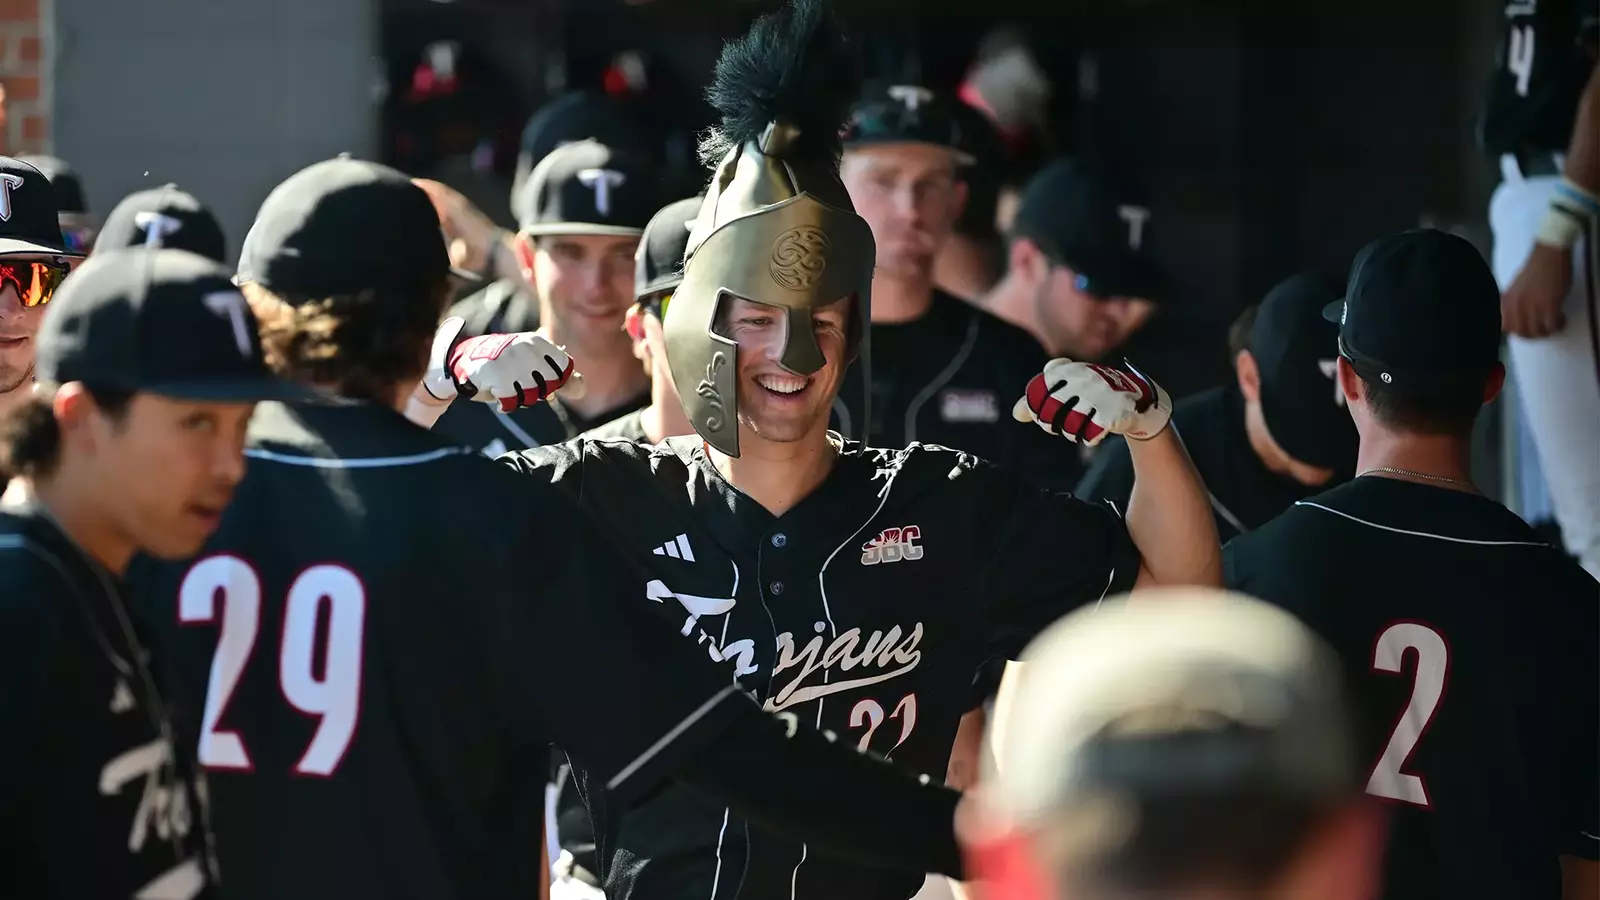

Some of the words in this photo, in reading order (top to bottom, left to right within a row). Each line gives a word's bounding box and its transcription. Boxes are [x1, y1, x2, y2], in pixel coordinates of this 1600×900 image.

[577, 168, 626, 216] T
[135, 211, 182, 248] T
[1117, 204, 1151, 251] T
[861, 525, 924, 566] SBC
[178, 552, 366, 779] 29
[1365, 619, 1451, 810] 2
